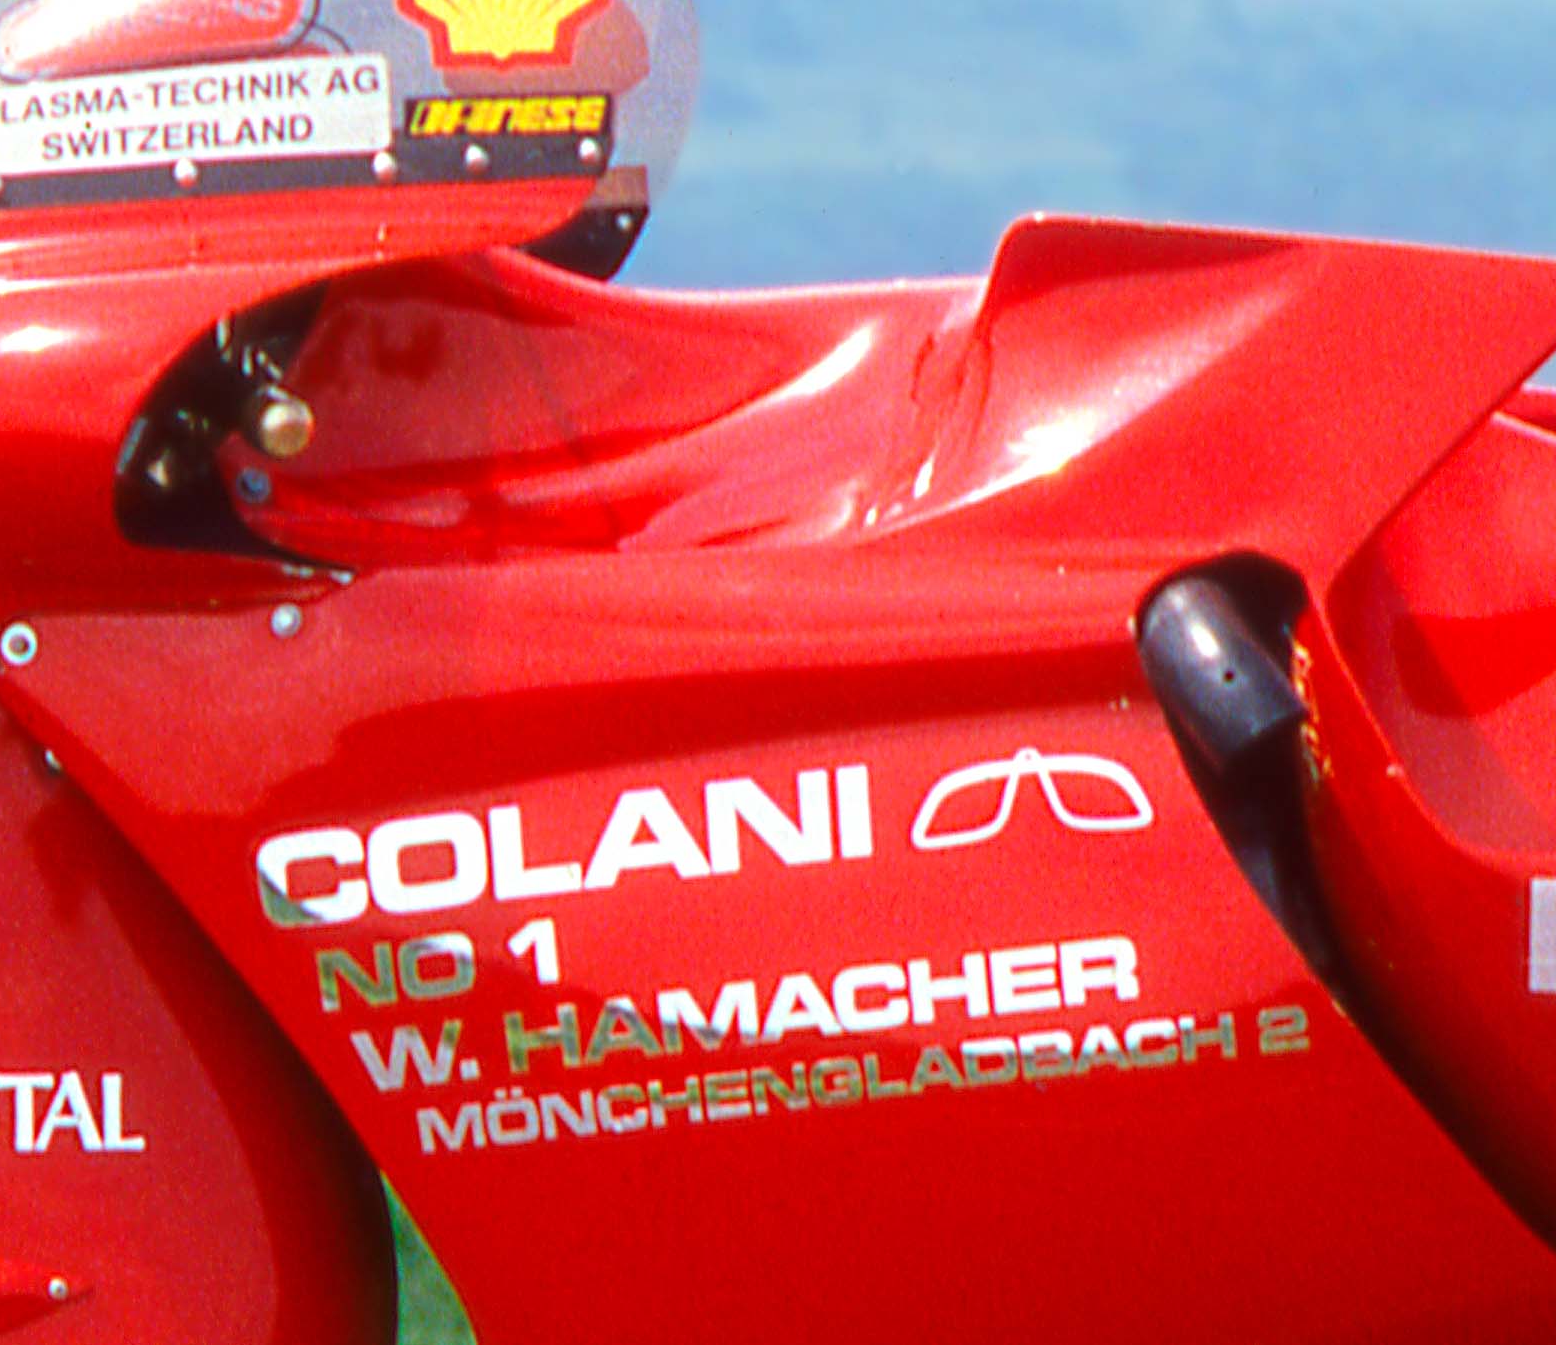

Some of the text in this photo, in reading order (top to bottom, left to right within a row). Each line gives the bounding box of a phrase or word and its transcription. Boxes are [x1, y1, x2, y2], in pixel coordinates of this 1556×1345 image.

[42, 114, 313, 161] SWITZERLAND
[325, 64, 380, 97] AG
[255, 765, 873, 928] COLANI
[315, 916, 562, 1013] NO 1
[350, 935, 1140, 1092] W. HAMACHER
[417, 1005, 1310, 1154] MÖNCHENGLADBACH 2
